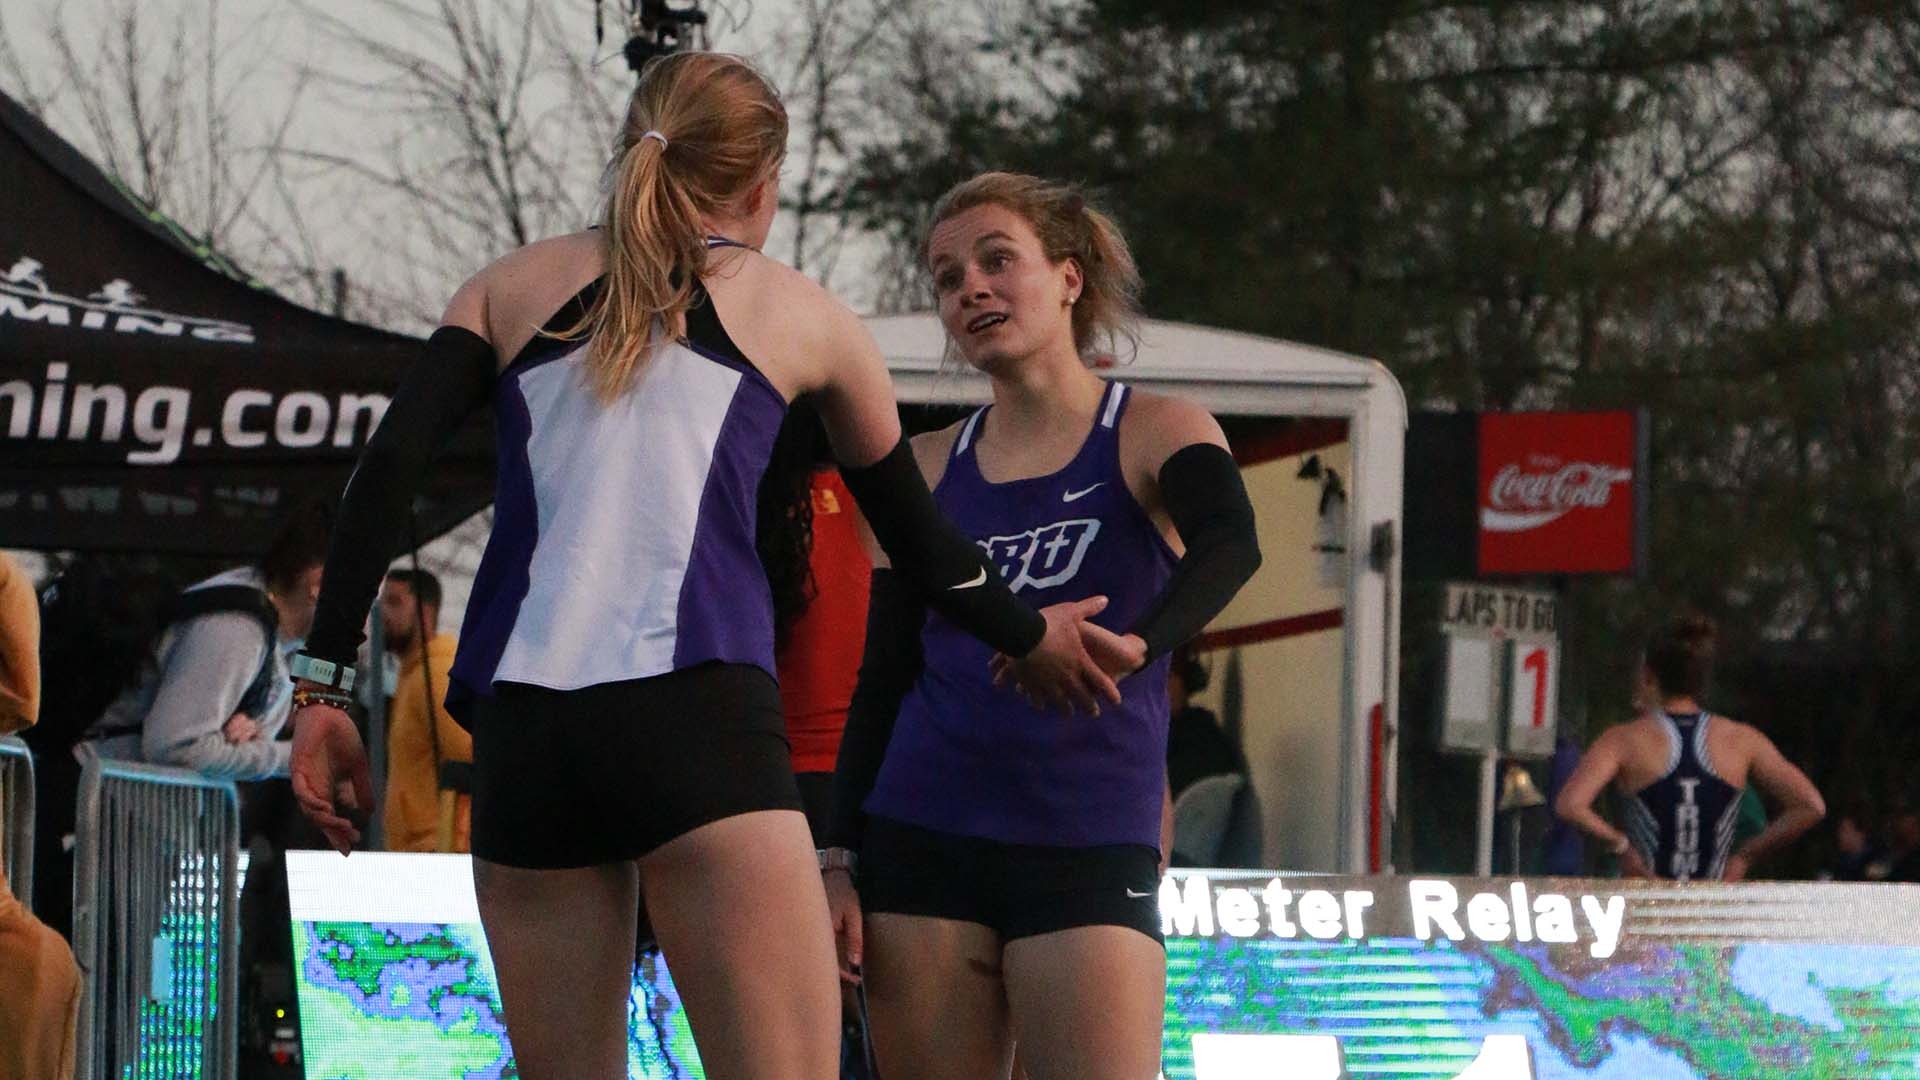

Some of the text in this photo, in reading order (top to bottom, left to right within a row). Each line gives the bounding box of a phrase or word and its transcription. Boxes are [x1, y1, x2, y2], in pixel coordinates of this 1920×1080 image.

[976, 519, 1101, 593] BU
[1503, 594, 1529, 629] TO
[1525, 650, 1547, 727] 1
[1158, 876, 1626, 959] Meter Relay
